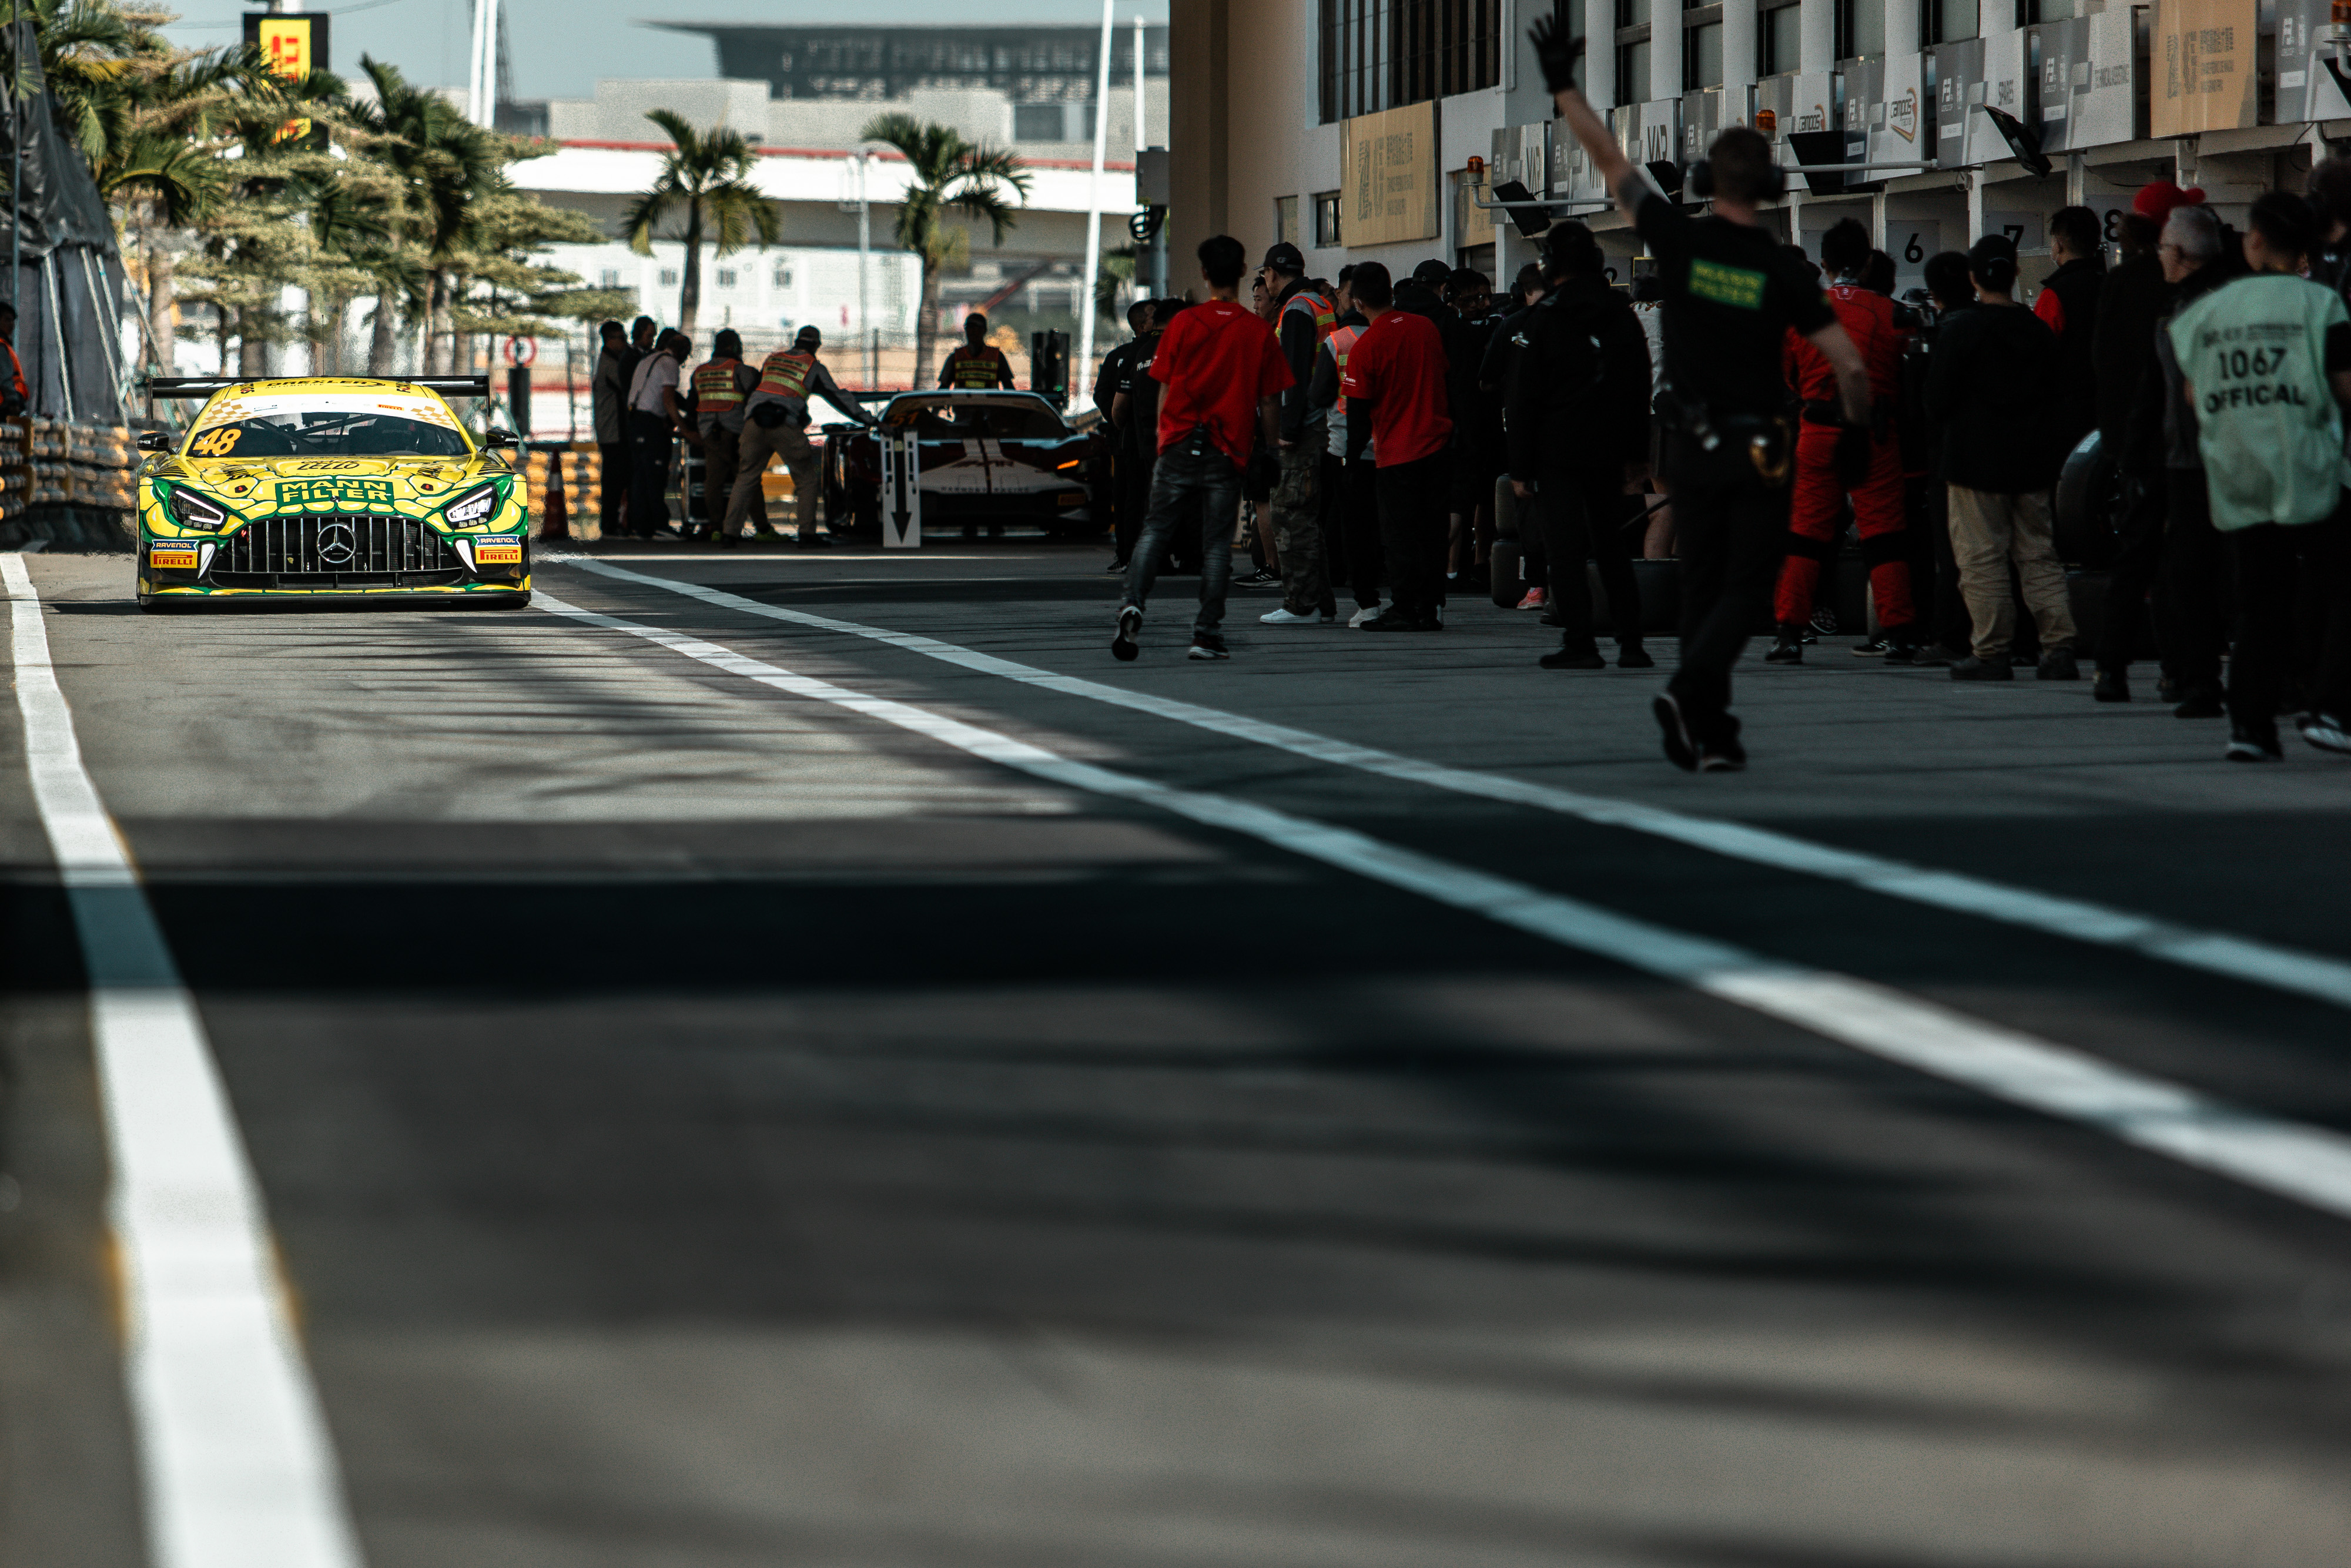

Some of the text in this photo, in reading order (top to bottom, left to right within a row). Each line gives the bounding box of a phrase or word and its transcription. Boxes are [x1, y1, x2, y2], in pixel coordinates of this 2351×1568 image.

[2004, 225, 2024, 249] 7
[1905, 233, 1923, 263] 6
[2219, 347, 2286, 380] 1067
[890, 411, 919, 427] 51
[193, 428, 242, 455] 48
[282, 480, 387, 492] MANN
[283, 488, 388, 503] FILTER
[153, 554, 193, 565] PIRELLI
[480, 550, 518, 560] PIRELLI
